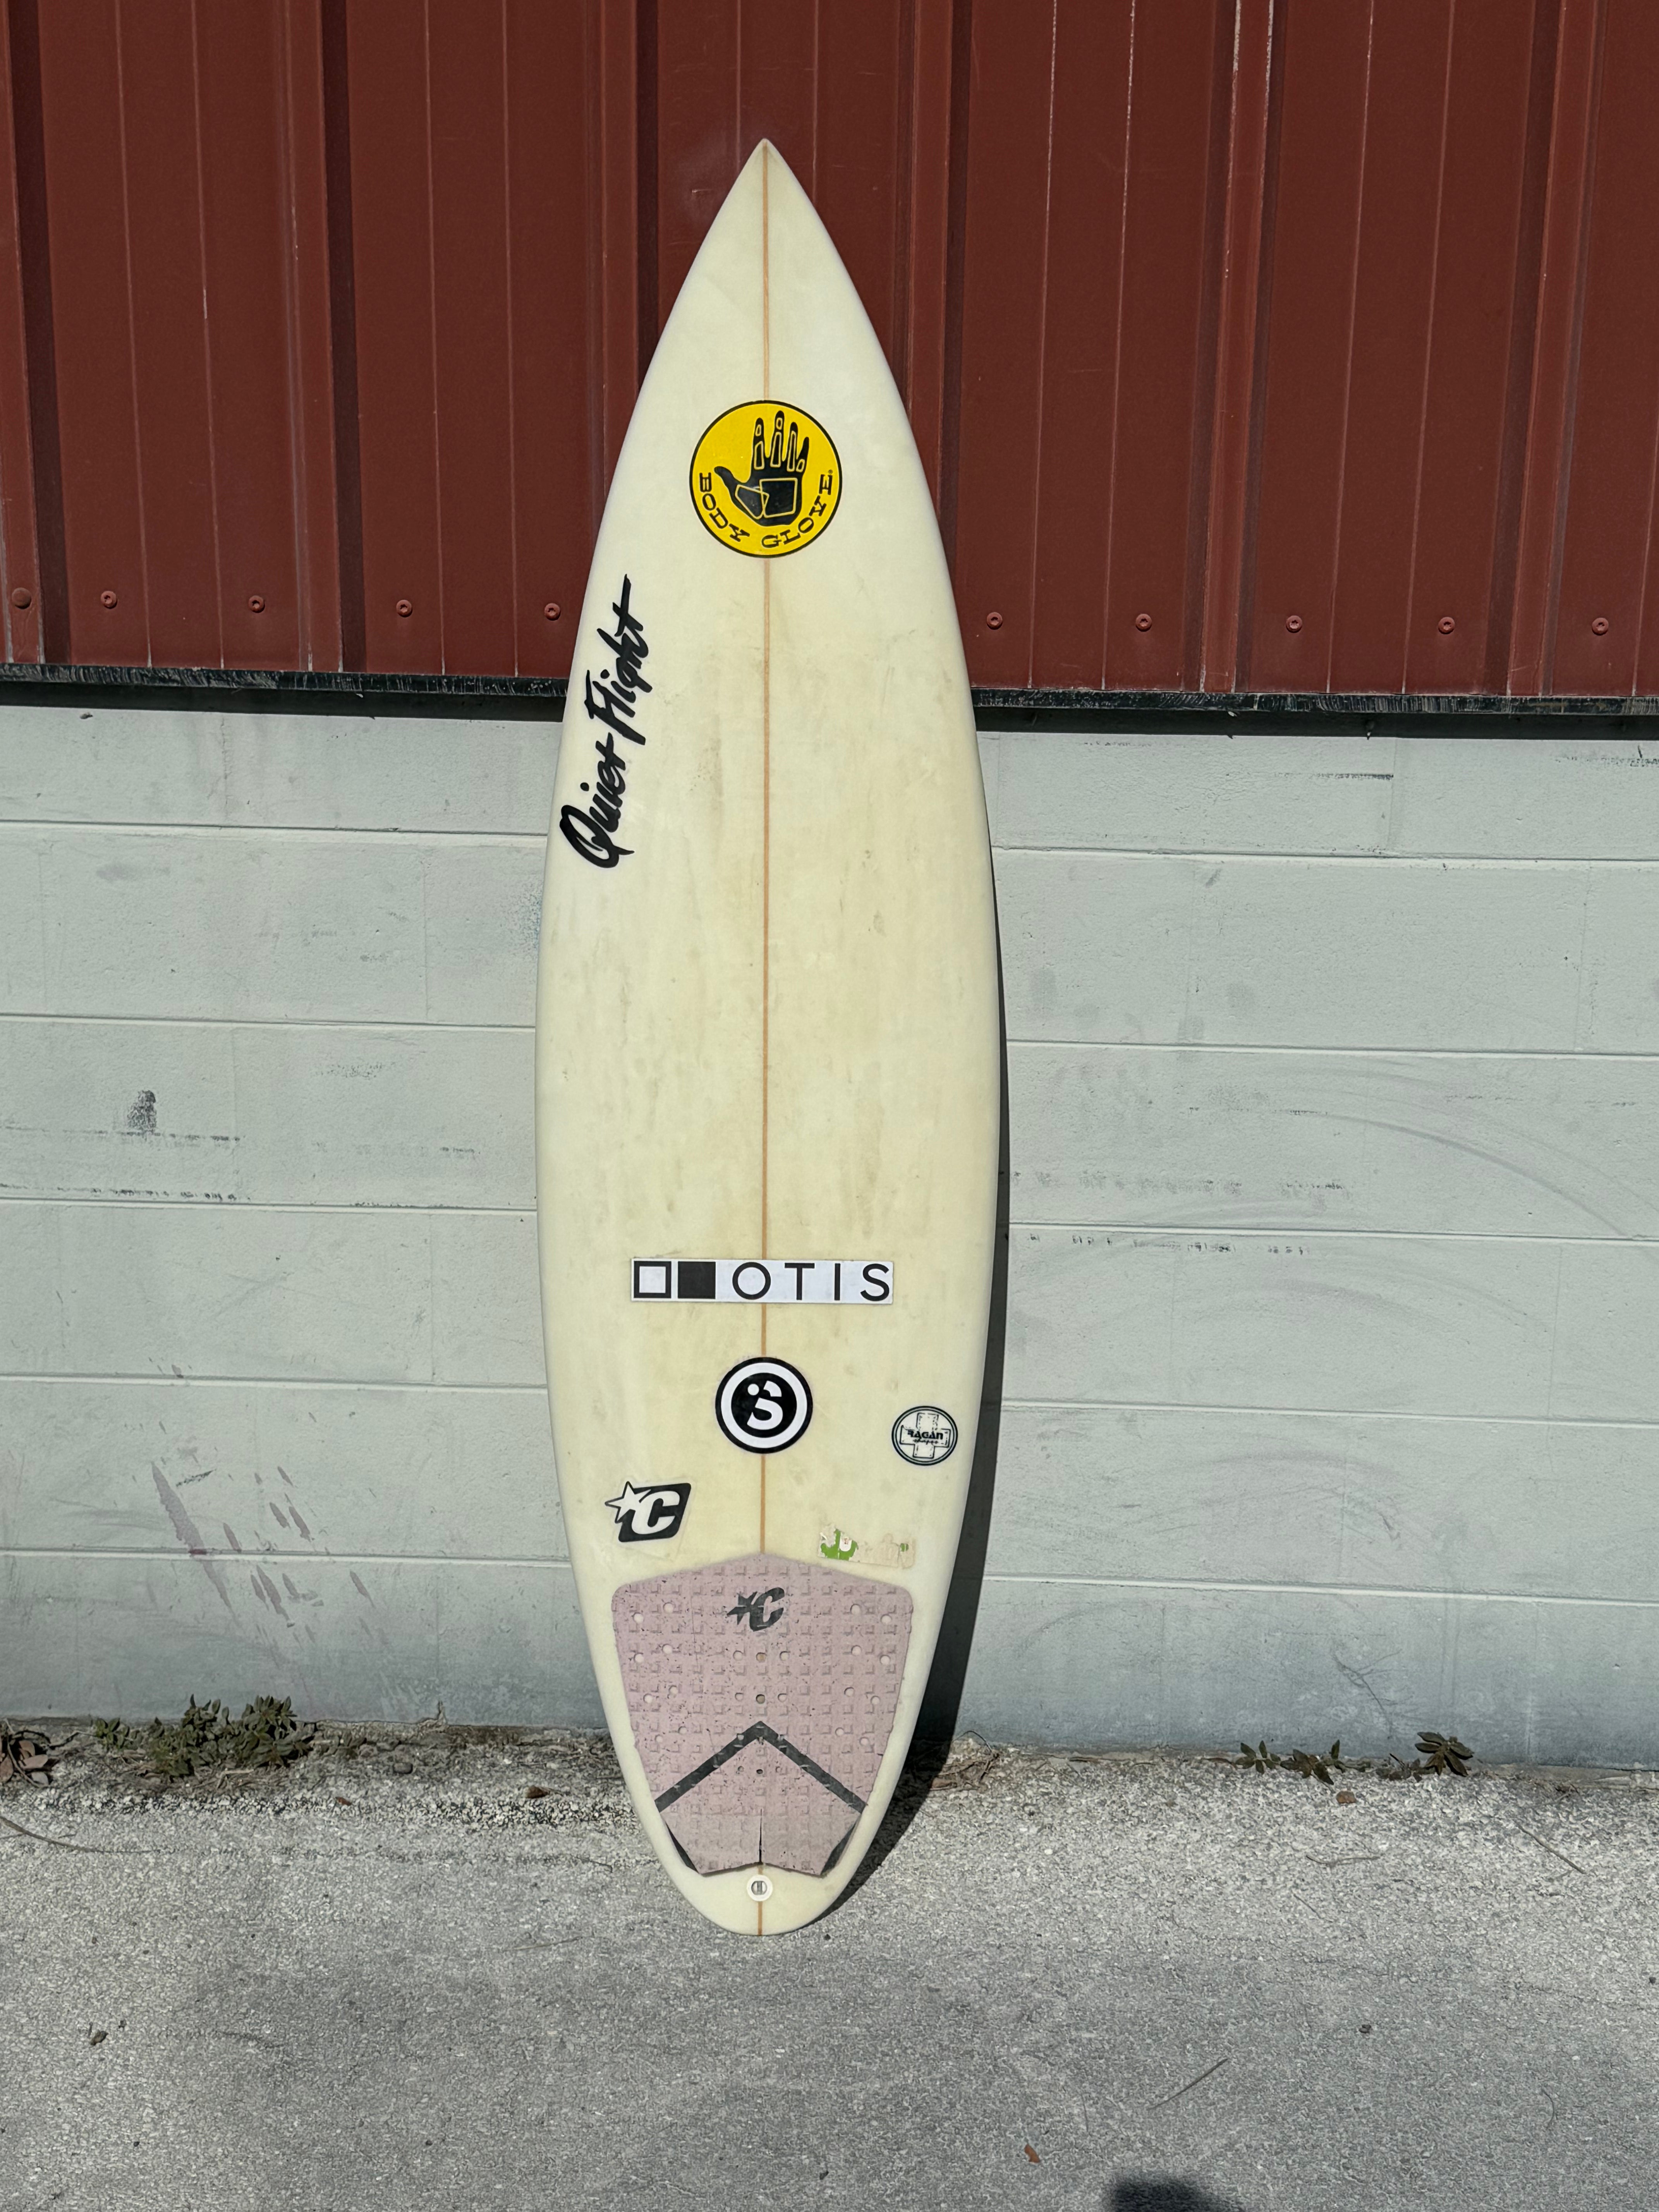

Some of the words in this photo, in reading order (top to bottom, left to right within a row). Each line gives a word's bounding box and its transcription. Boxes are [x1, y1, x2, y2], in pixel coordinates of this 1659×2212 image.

[699, 472, 750, 542] BODY
[584, 574, 653, 745] Flight
[559, 732, 635, 868] Quiet
[732, 1261, 890, 1302] OTIS
